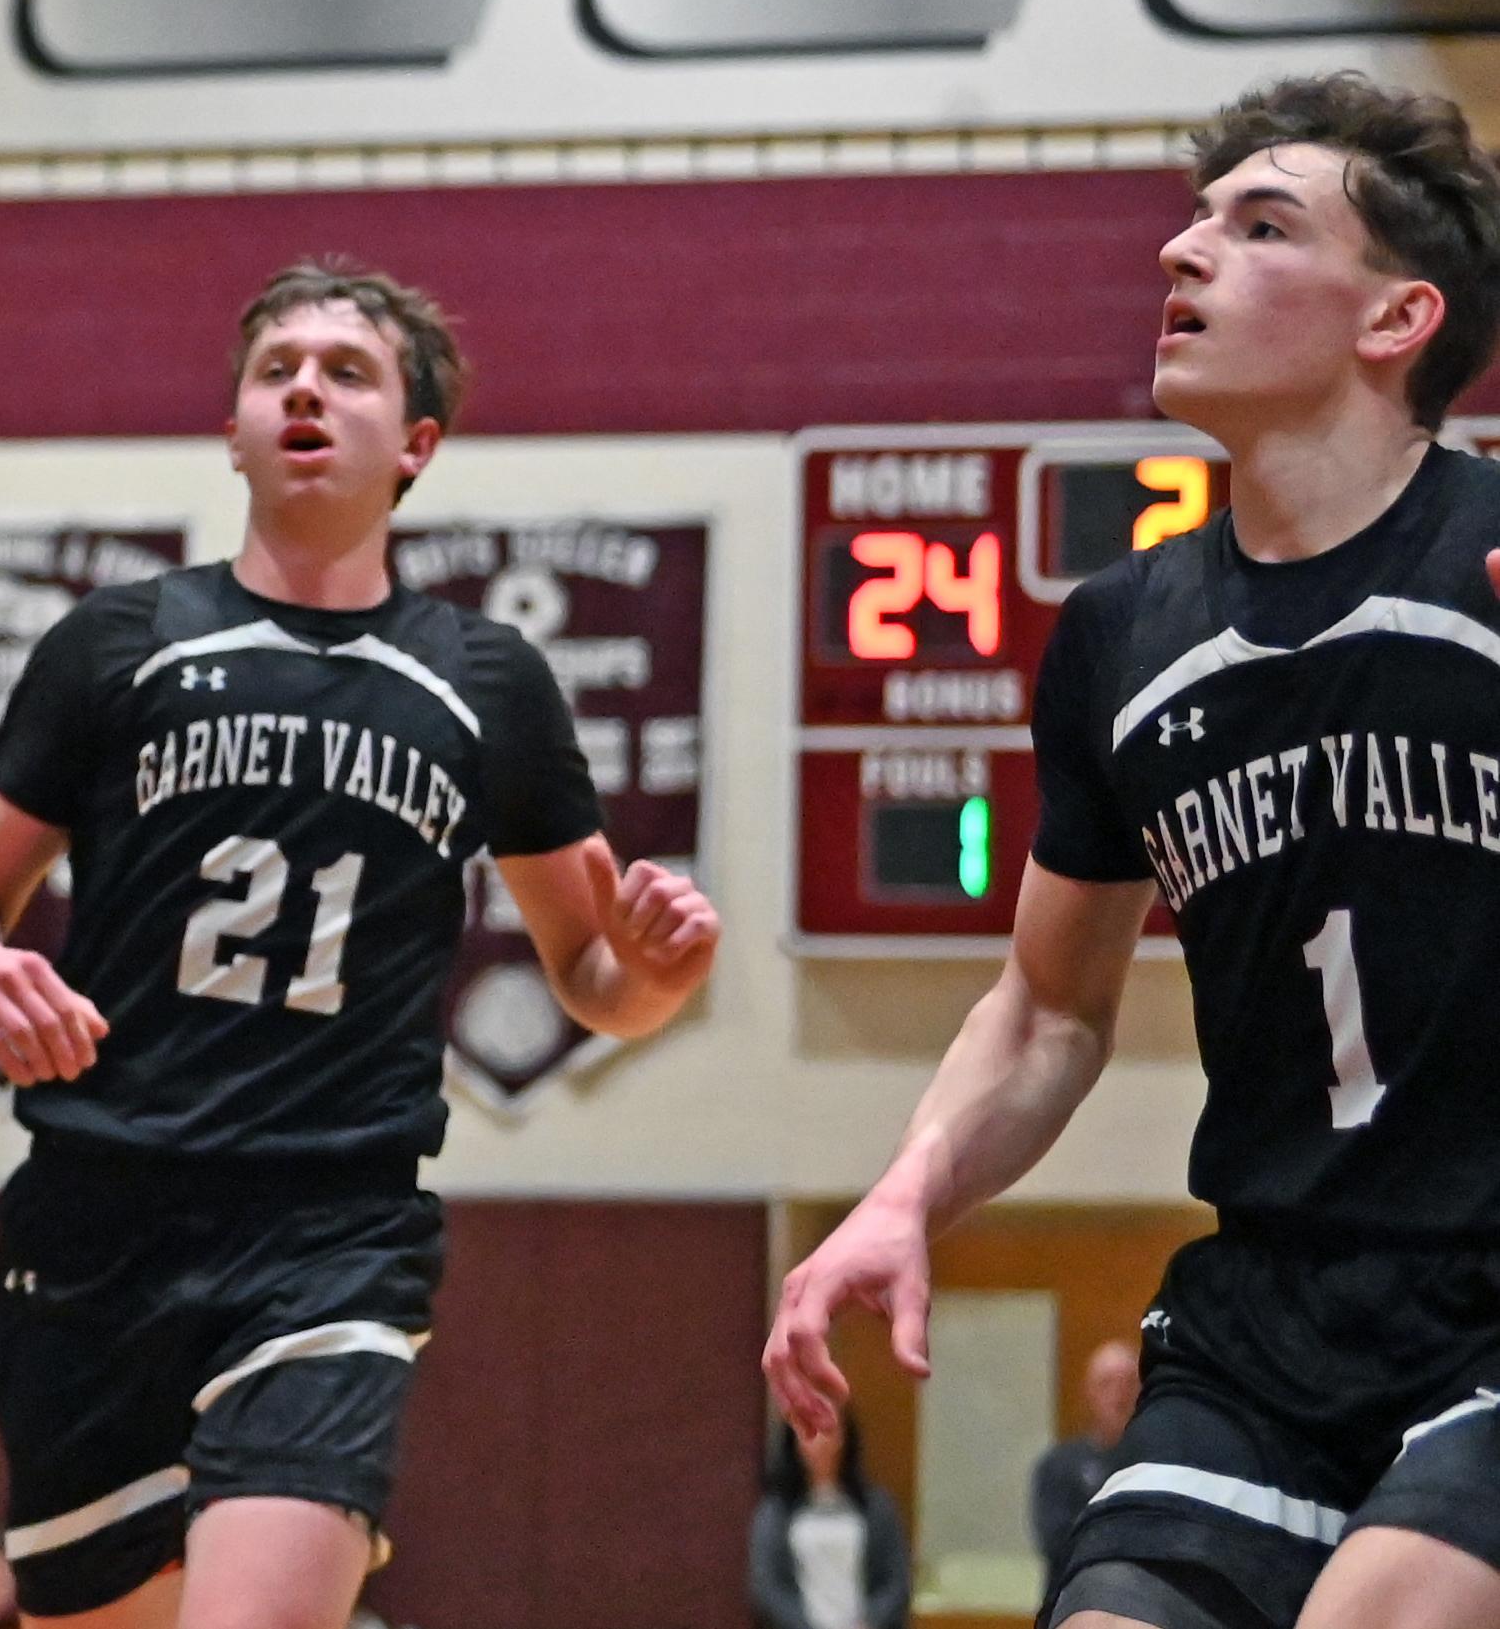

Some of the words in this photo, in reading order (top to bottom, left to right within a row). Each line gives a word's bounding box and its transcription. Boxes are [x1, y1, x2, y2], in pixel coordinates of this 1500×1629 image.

[828, 454, 992, 519] HOME
[848, 530, 1001, 660] 24
[883, 670, 1025, 723] BONUS
[137, 713, 308, 816] GARNET
[322, 719, 467, 859] VALLEY
[860, 748, 990, 800] FOULS
[1141, 744, 1309, 914] GARNET
[958, 796, 992, 899] 1
[177, 835, 365, 1016] 21
[1303, 909, 1387, 1130] 1
